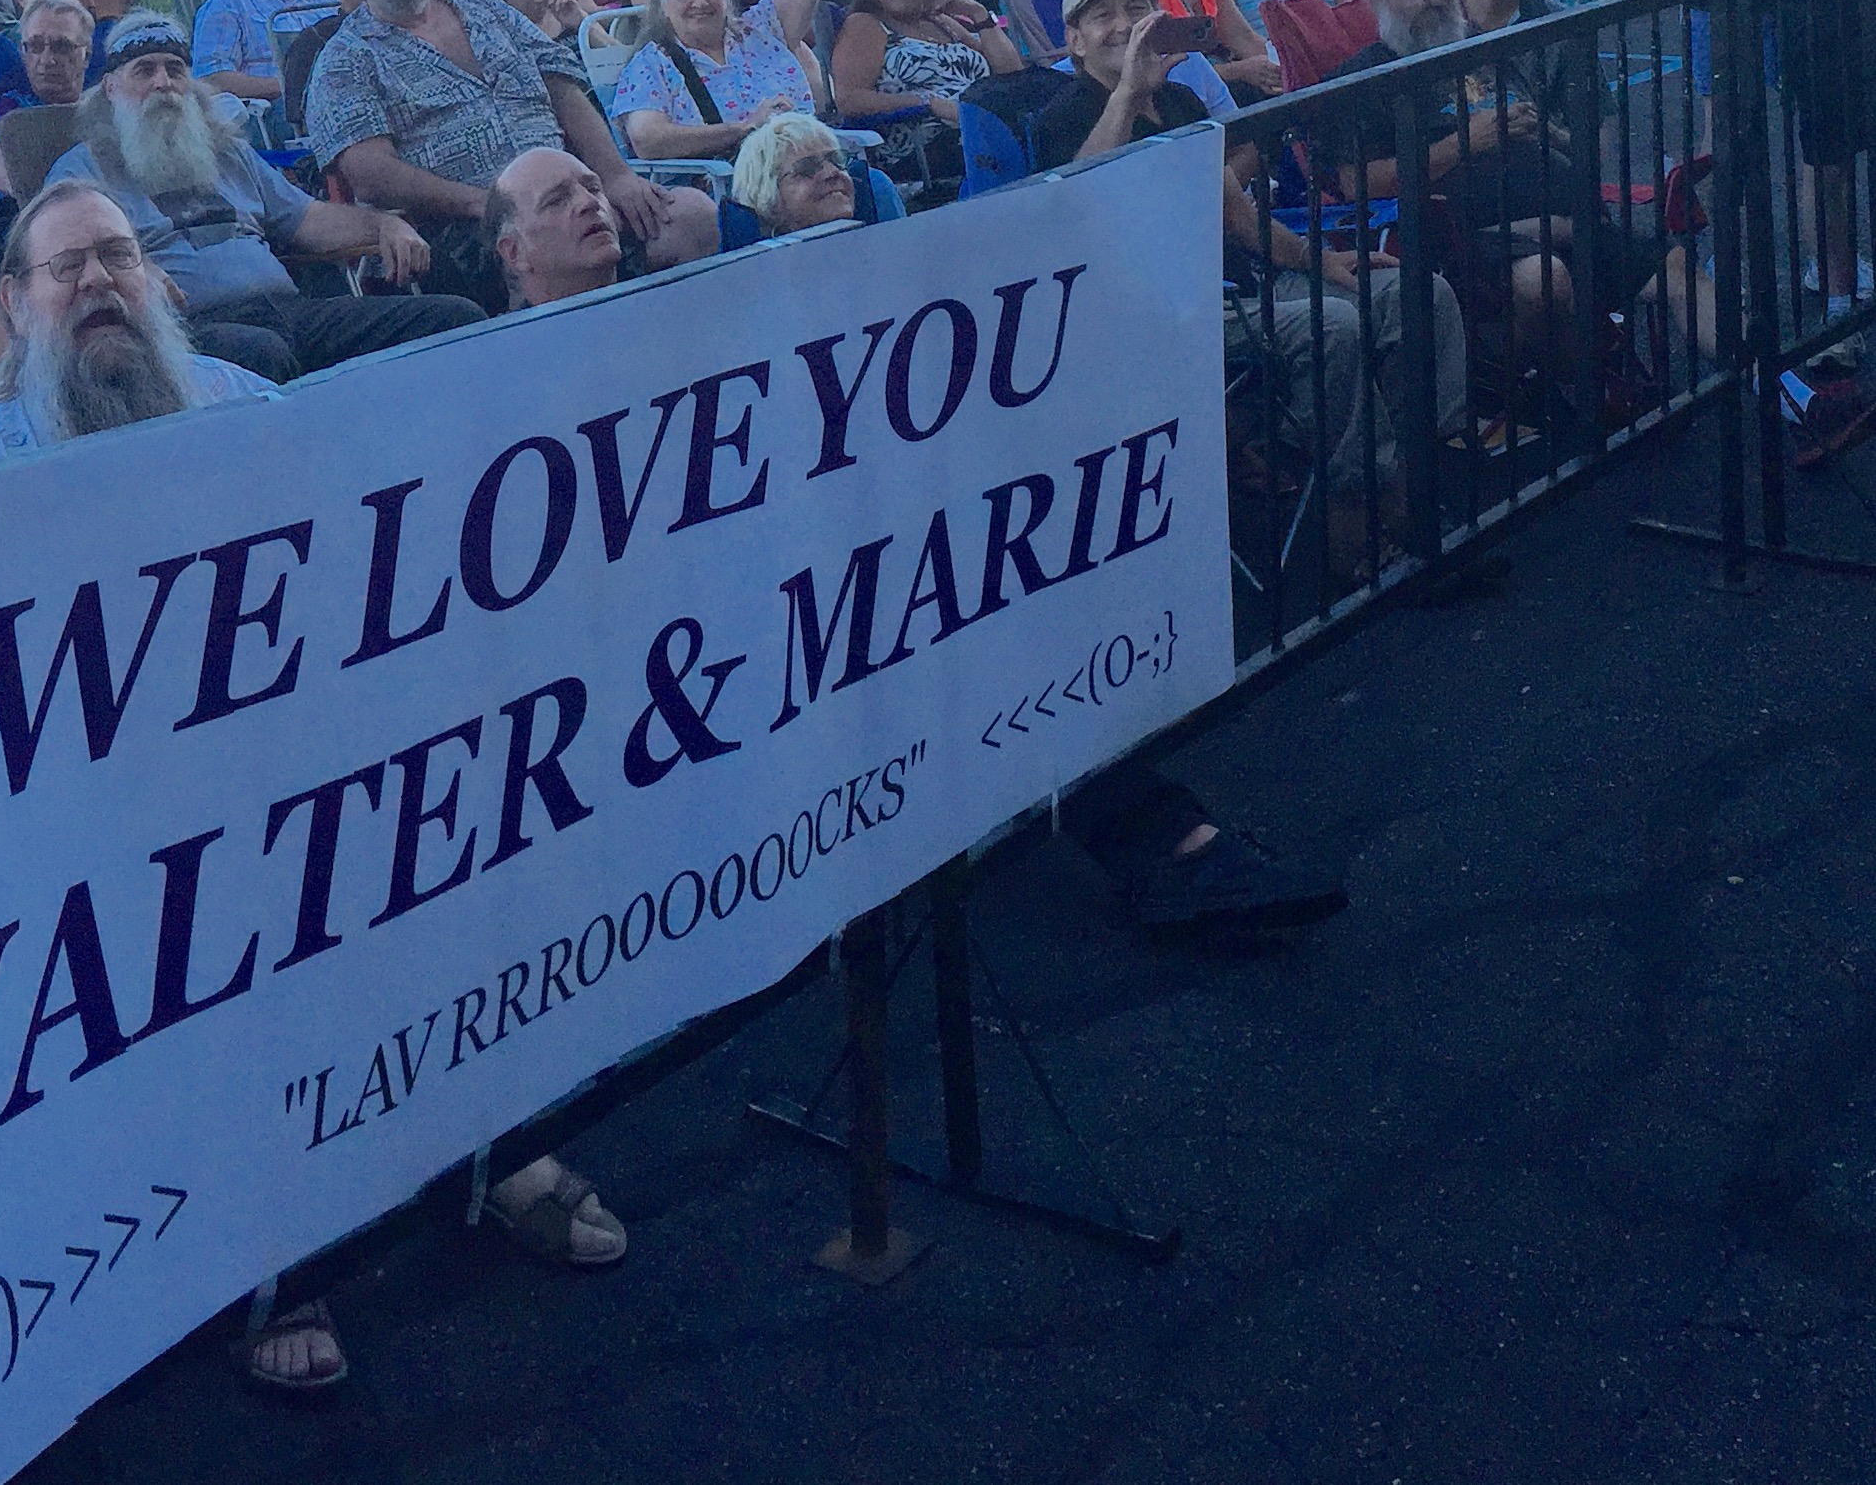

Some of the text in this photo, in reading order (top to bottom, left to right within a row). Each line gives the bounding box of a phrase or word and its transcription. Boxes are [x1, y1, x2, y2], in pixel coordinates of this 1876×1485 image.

[341, 360, 770, 669] LOVE
[795, 264, 1086, 480] YOU
[624, 618, 746, 788] &
[770, 418, 1179, 733] MARIE
